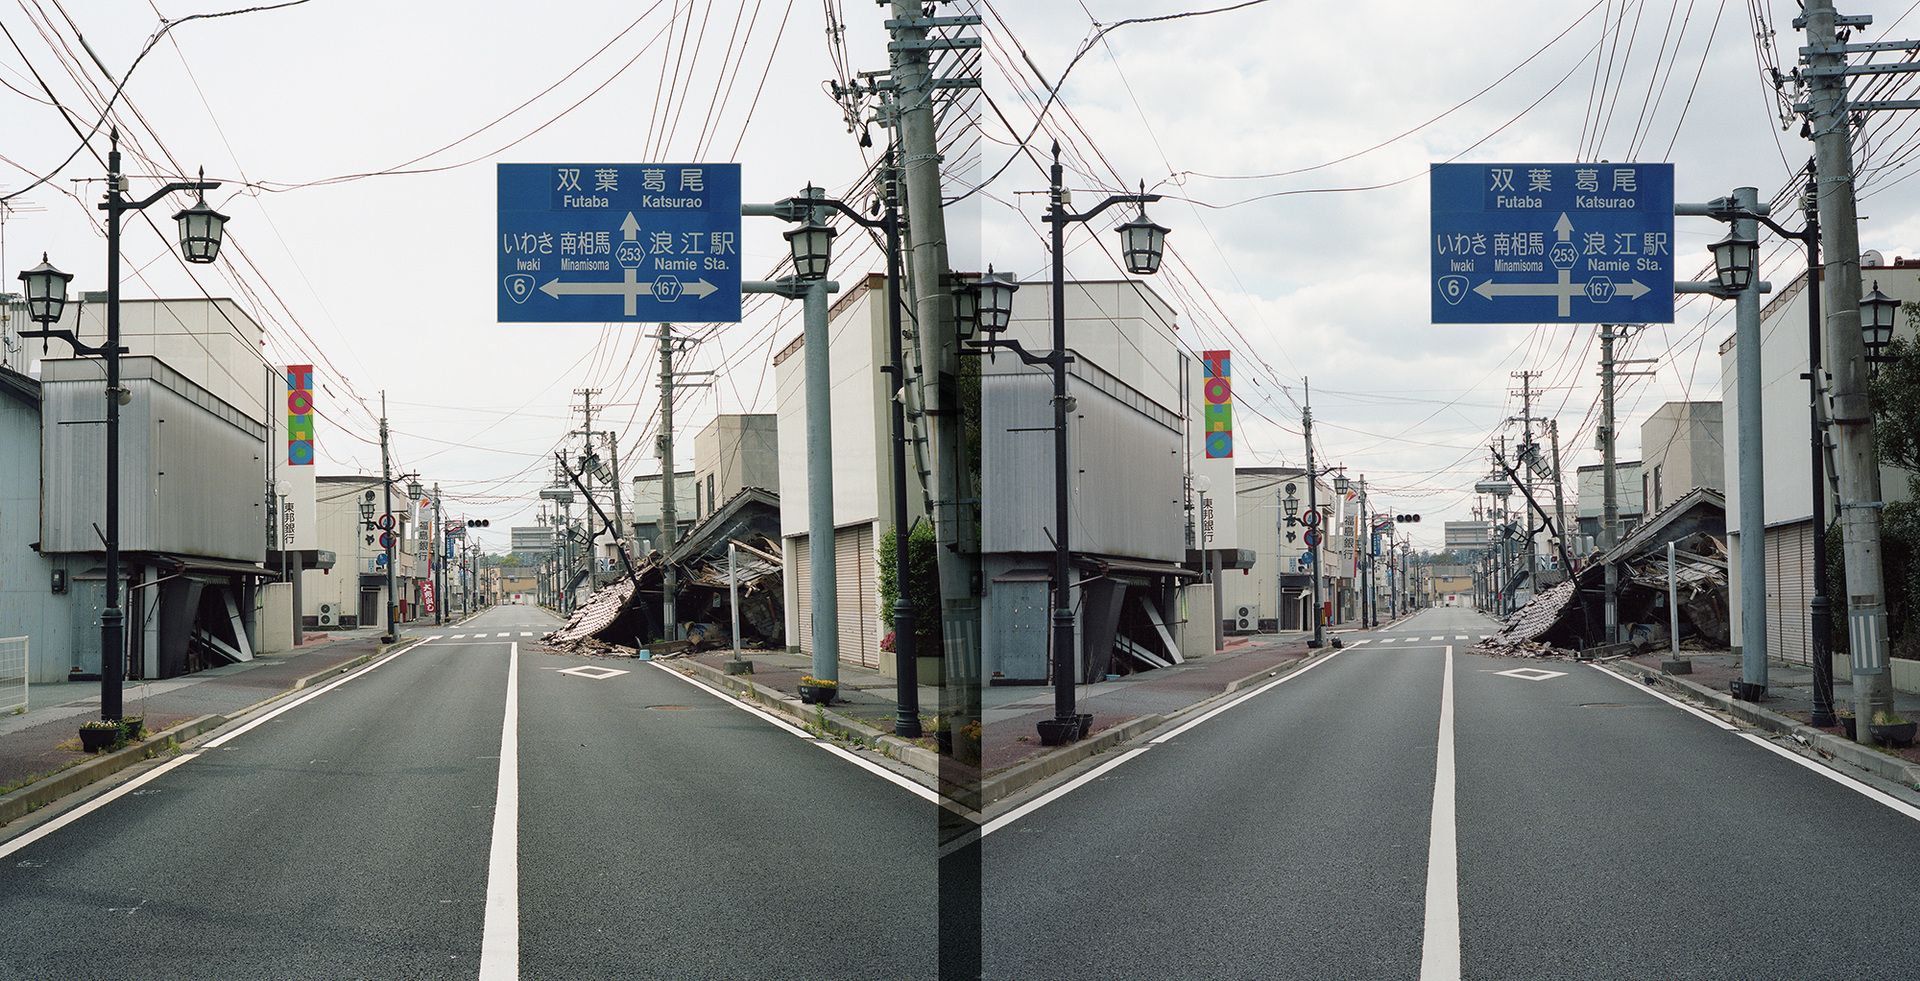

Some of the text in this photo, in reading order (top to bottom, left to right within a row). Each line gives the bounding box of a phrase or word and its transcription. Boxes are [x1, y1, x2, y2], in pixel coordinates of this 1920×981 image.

[557, 168, 705, 192] 双葉 葛尾
[1490, 168, 1637, 192] 双葉 葛尾
[563, 195, 703, 208] Futaba Katsurao
[1497, 195, 1636, 209] Futaba Katsurao
[503, 231, 611, 255] いわき 南相馬
[649, 230, 736, 255] 浪江駅
[1437, 232, 1544, 256] いわき 南相馬
[1582, 231, 1669, 256] 浪江駅
[619, 248, 641, 261] 253
[1553, 249, 1575, 262] 253
[517, 258, 610, 271] Iwaki Minamisoma
[655, 258, 730, 271] Namie Sta.
[1450, 259, 1544, 272] Iwaki Minamisoma
[1588, 259, 1663, 271] Namie Sta.
[513, 278, 526, 294] 6
[656, 282, 677, 296] 167
[1447, 280, 1460, 295] 6
[1589, 282, 1610, 296] 167
[284, 502, 295, 544] 東邦銀行
[1203, 498, 1214, 543] 東邦銀行
